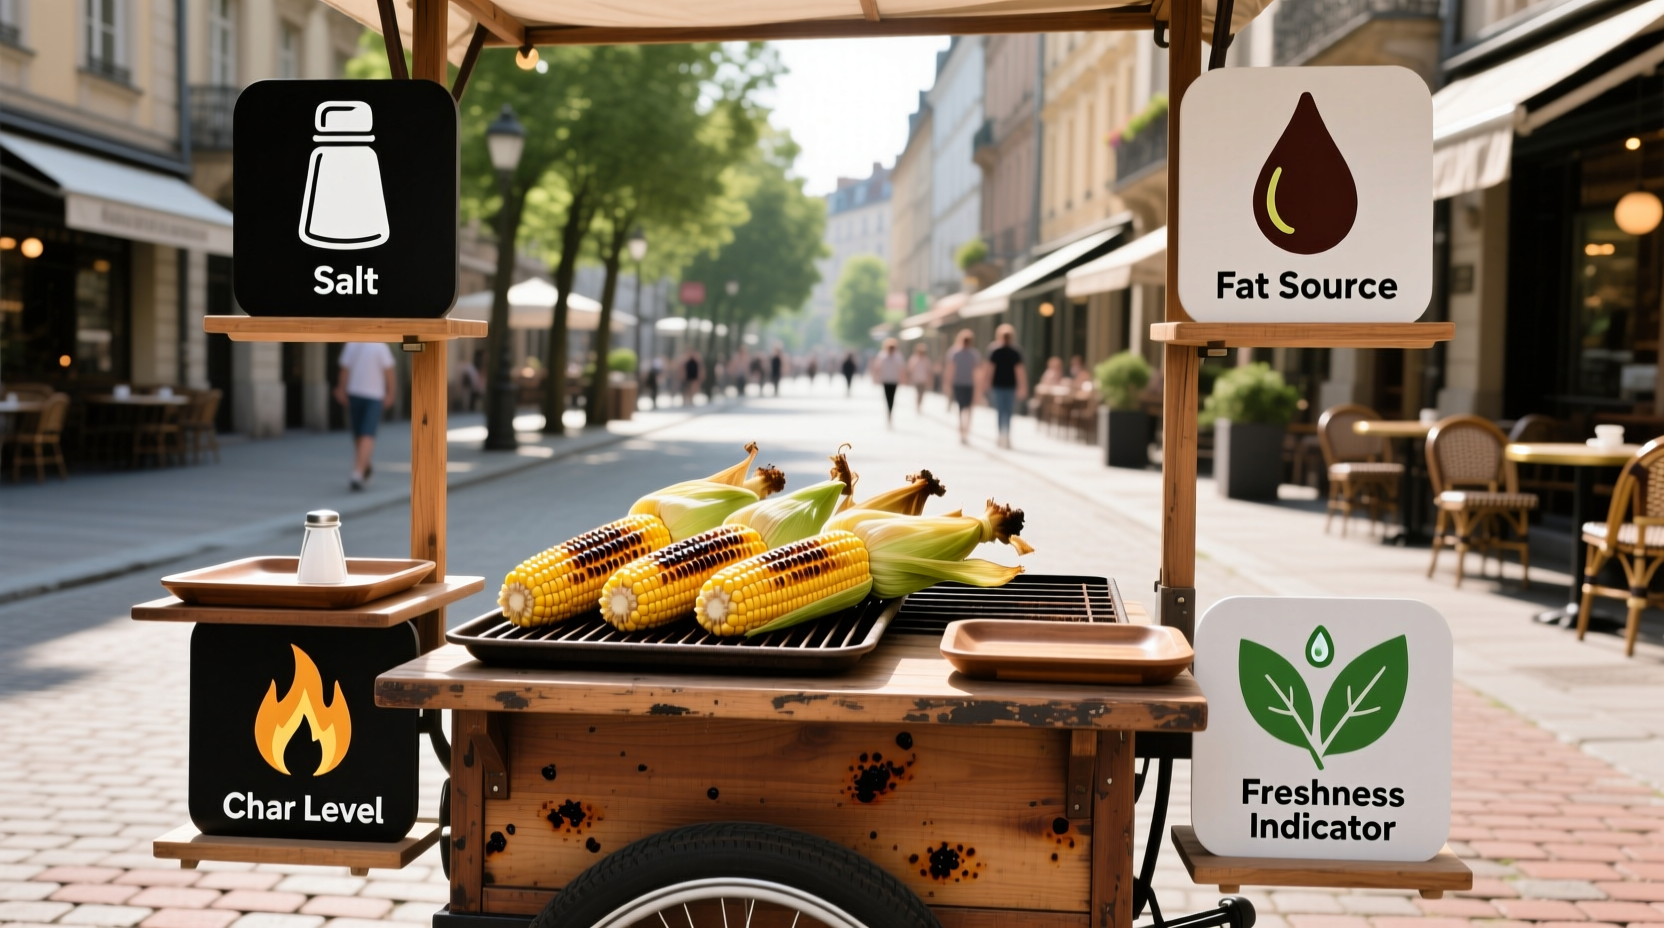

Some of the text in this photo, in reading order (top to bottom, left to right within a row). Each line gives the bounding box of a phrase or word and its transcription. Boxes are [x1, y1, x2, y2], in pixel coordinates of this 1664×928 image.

[313, 265, 379, 295] Salt
[1217, 270, 1398, 300] Fat Source
[223, 791, 384, 824] Char Level
[1242, 778, 1405, 808] Freshness
[1250, 811, 1397, 841] Indicator
